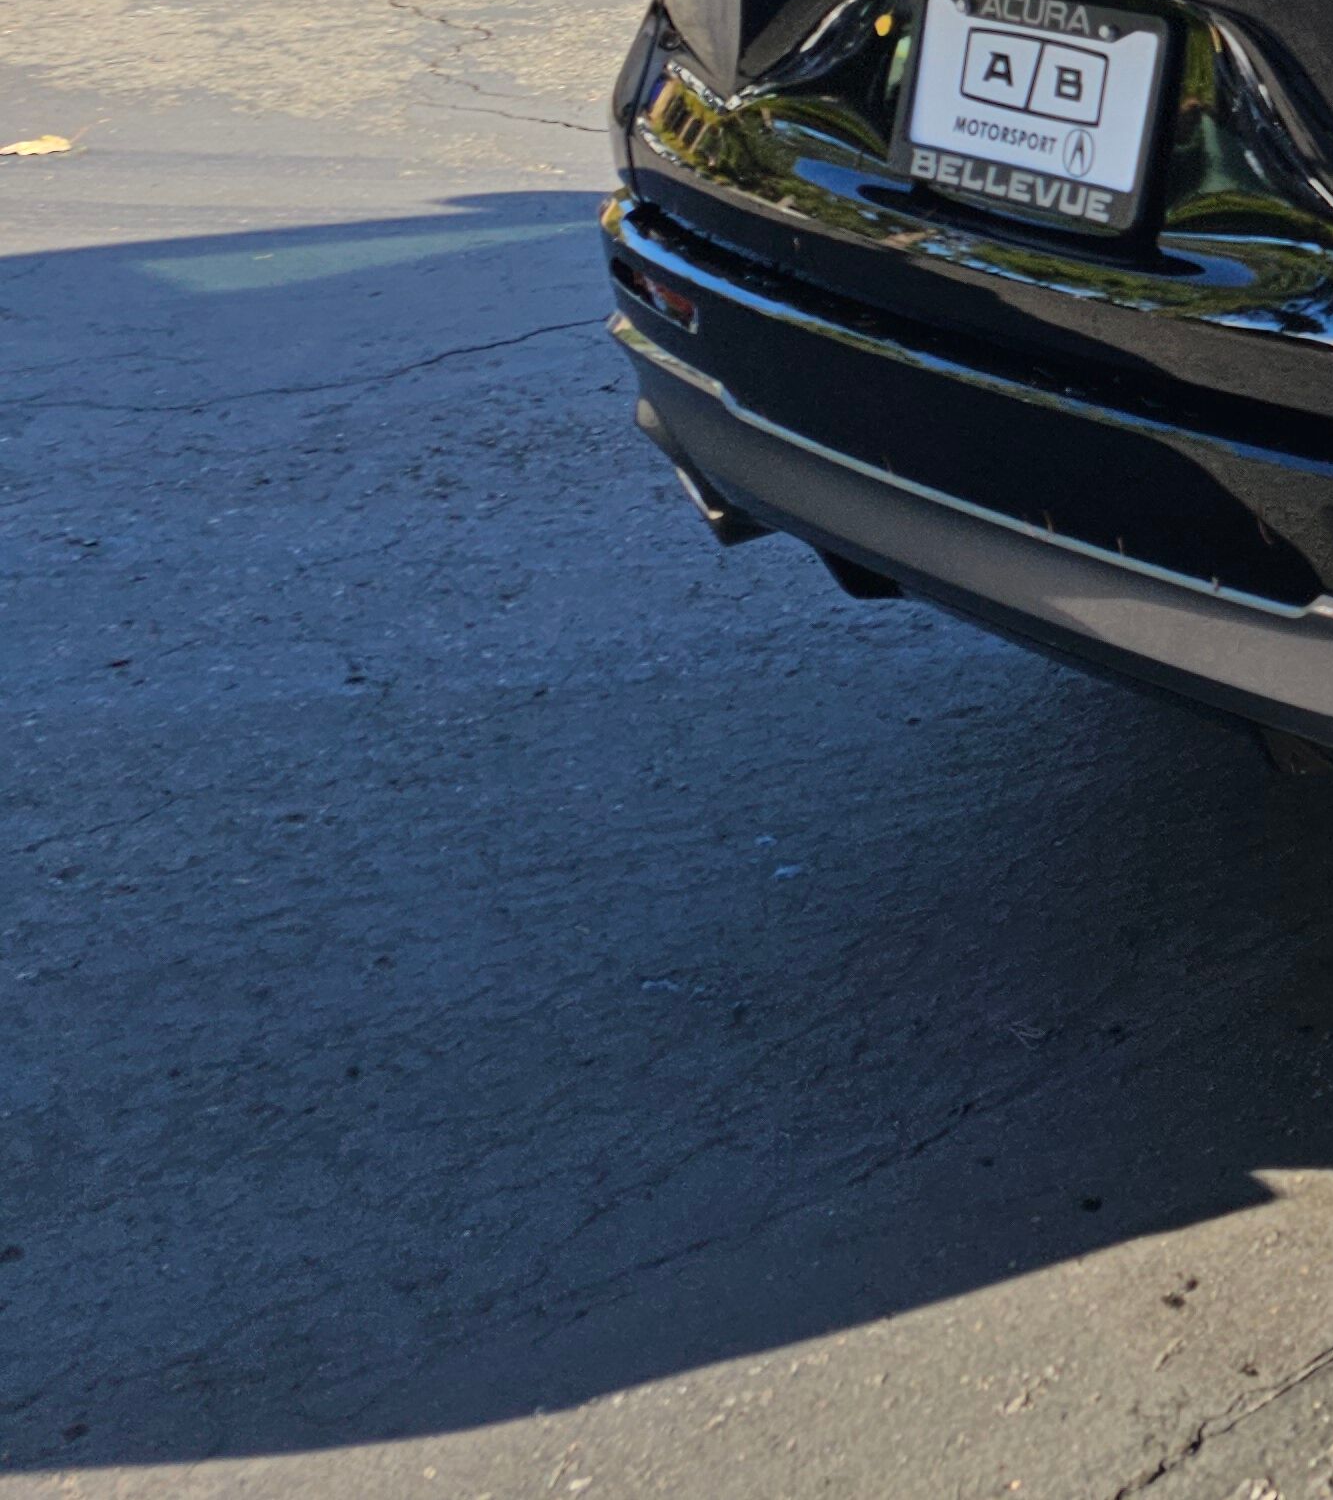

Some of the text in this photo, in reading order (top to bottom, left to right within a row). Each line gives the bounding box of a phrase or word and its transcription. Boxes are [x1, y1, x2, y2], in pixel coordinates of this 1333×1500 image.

[983, 51, 1083, 102] A B
[953, 115, 1058, 153] MOTORSPORT
[909, 150, 1113, 223] BELLEVUE
